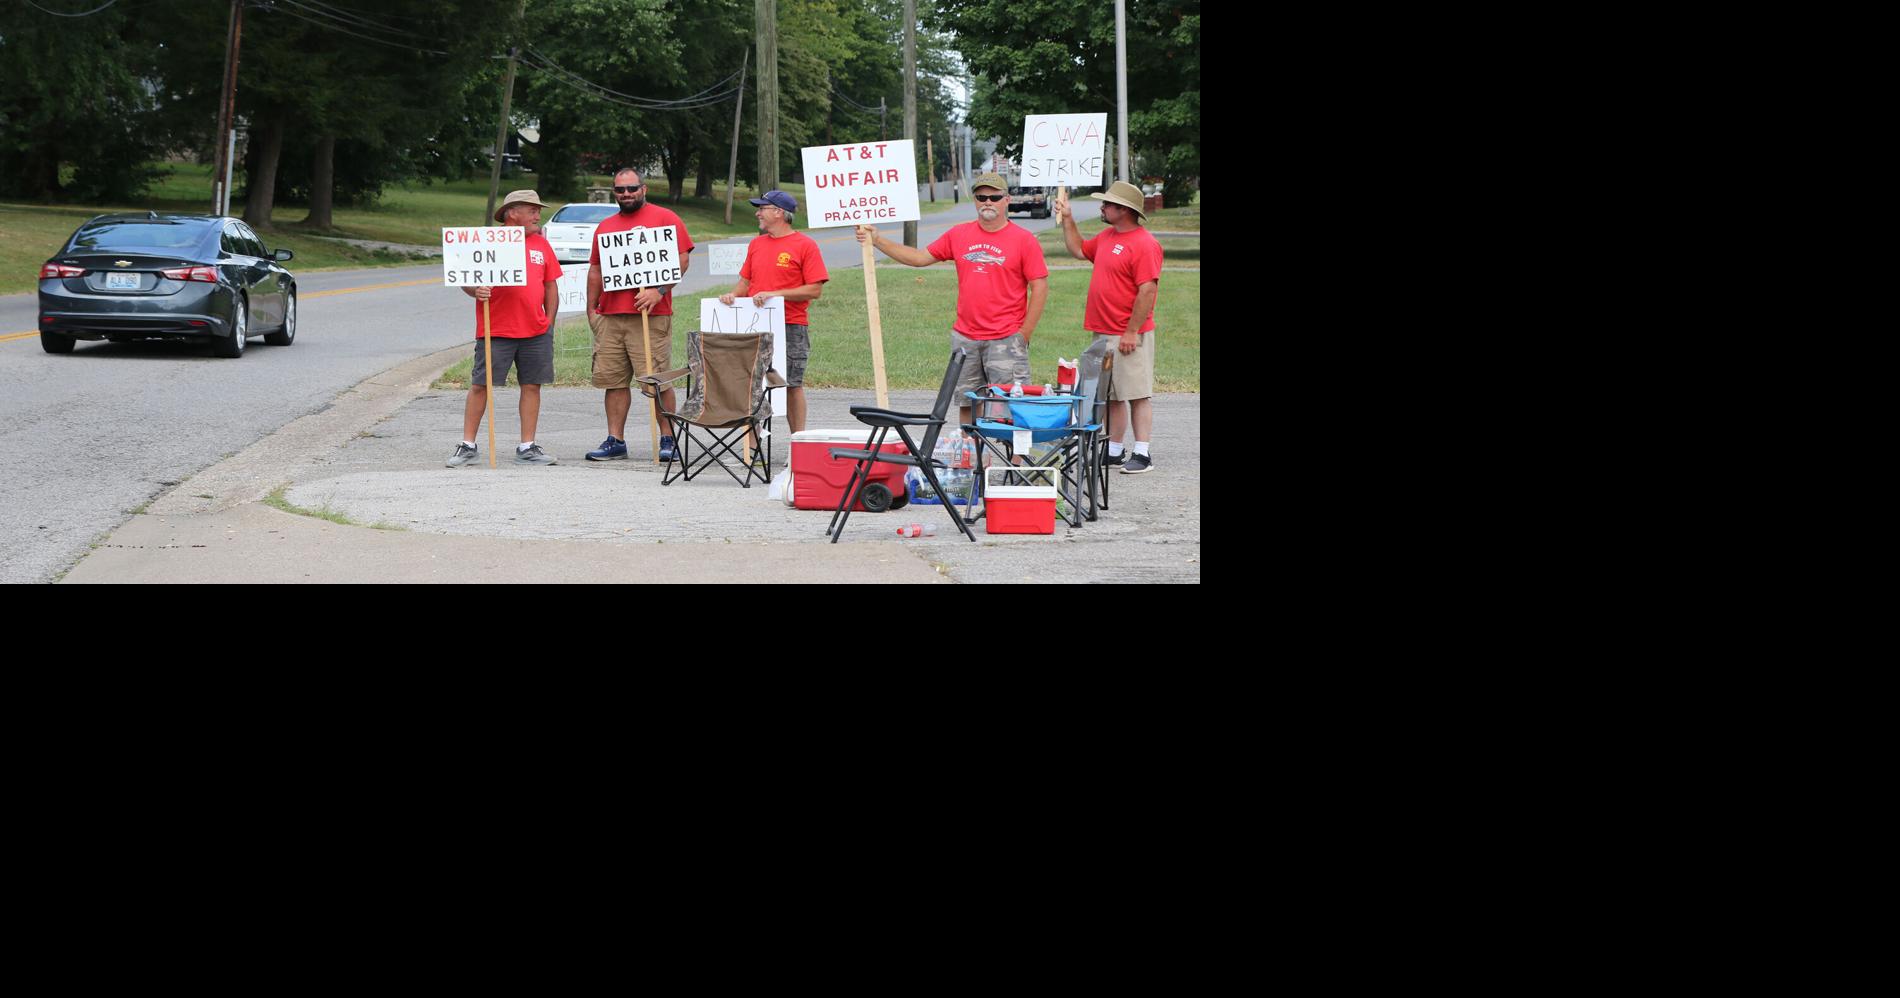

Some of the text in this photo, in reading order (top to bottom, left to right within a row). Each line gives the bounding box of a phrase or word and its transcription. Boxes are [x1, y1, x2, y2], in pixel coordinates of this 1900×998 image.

[1032, 121, 1101, 148] CWA
[826, 144, 888, 163] AT&T
[1028, 156, 1102, 178] STRIKE
[815, 168, 900, 189] UNFAIR
[839, 195, 889, 209] LABOR
[824, 207, 897, 223] PRACTICE
[444, 229, 523, 244] CWA 3312
[601, 228, 673, 248] UNFAIR
[473, 250, 496, 263] ON
[609, 249, 669, 268] LABOR
[447, 270, 523, 283] STRIKE
[602, 268, 681, 289] PRACTICE
[559, 290, 587, 305] NFA
